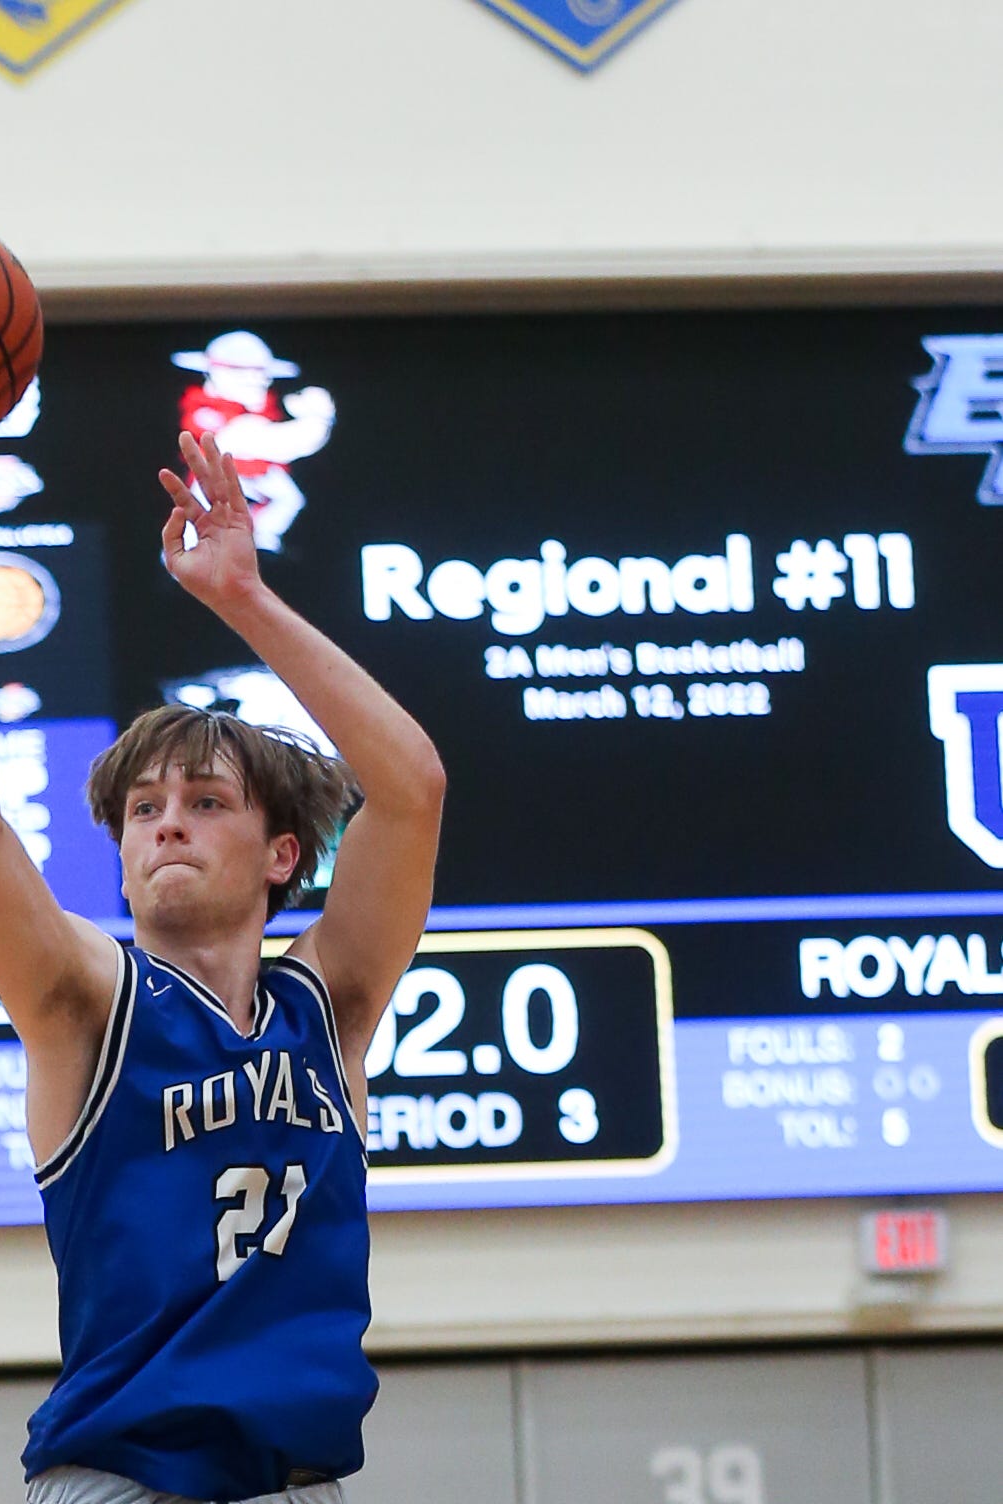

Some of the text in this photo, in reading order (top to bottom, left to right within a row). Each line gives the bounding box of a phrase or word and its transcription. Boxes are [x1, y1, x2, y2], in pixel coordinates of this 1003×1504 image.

[361, 532, 916, 635] Regional #11
[798, 933, 1003, 999] ROYAL
[367, 1087, 600, 1152] ERIOD 3
[214, 1163, 307, 1282] 21
